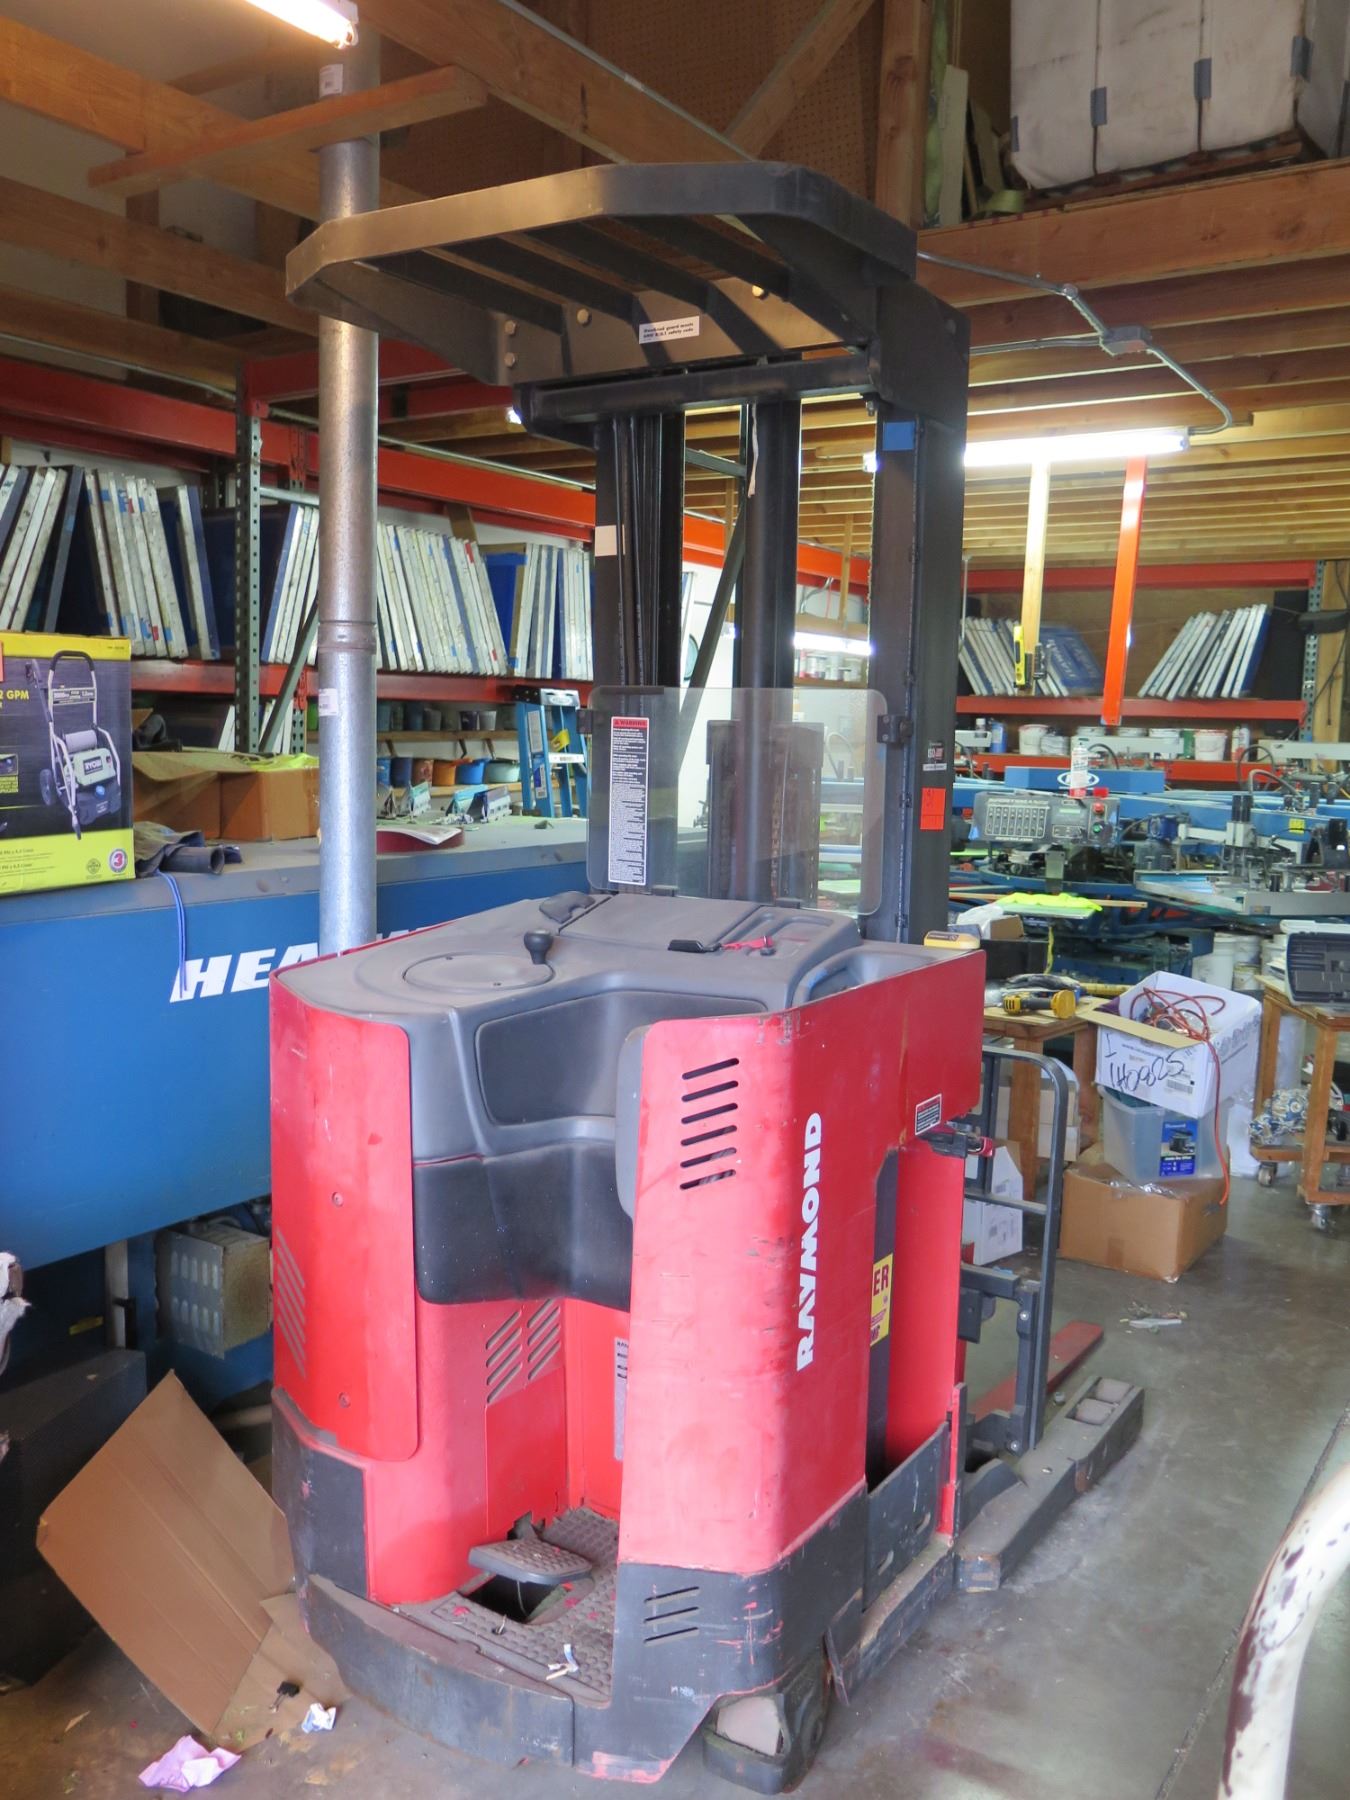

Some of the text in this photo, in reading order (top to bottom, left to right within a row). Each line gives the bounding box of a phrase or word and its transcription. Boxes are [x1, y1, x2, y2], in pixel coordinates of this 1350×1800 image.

[6, 689, 29, 700] GPM
[113, 852, 123, 867] 3
[796, 1112, 822, 1372] RAYMOND
[873, 1264, 889, 1296] ER
